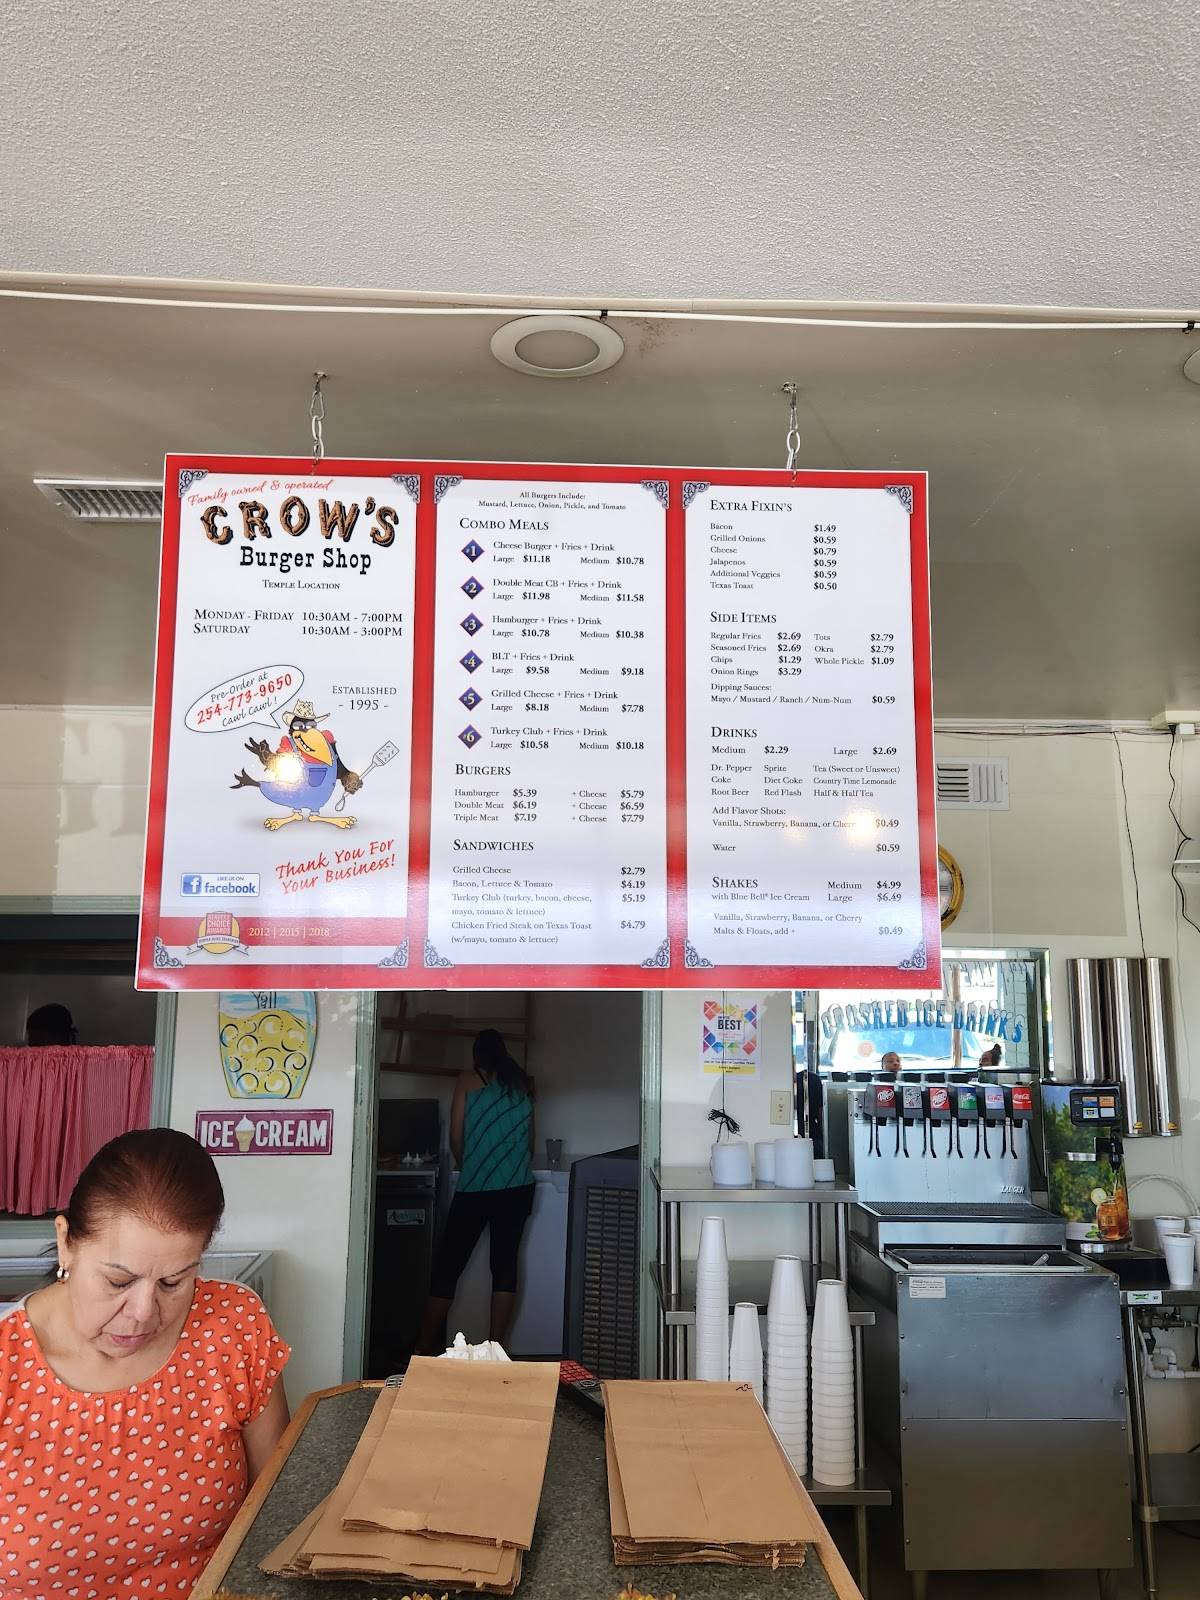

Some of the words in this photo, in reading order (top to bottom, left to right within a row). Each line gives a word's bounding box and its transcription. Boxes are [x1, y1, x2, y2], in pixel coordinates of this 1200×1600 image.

[187, 490, 228, 507] Family
[230, 484, 266, 499] owned
[270, 479, 280, 492] &
[284, 479, 334, 492] operated
[532, 492, 556, 500] Burgers
[711, 500, 747, 510] EXTRA
[200, 495, 400, 548] CROW'S
[814, 524, 836, 532] $1.49
[813, 536, 836, 544] $0.59
[525, 542, 552, 551] Burger
[240, 546, 314, 573] Burger
[323, 548, 371, 575] Shop
[494, 555, 514, 563] Large
[710, 558, 745, 566] Jalapenos
[814, 559, 836, 567] $0.59
[752, 571, 780, 579] Veggies
[814, 582, 837, 590] $0.50
[522, 592, 550, 600] $11.98
[617, 594, 644, 602] $11.58
[304, 612, 349, 621] 10:30AM
[362, 613, 402, 622] 7:00PM
[493, 616, 538, 625] Hamburger
[194, 623, 249, 633] SATURDAY
[303, 626, 349, 635] 10:30AM
[362, 627, 401, 636] 3:00PM
[493, 629, 513, 637] Large
[522, 629, 549, 637] $10.78
[616, 631, 644, 639] $10.38
[711, 632, 740, 640] Regular
[778, 632, 801, 640] $2.69
[778, 644, 801, 652] $2.69
[871, 645, 894, 653] $2.79
[711, 656, 732, 664] Chips
[210, 677, 255, 703] Pre-Order
[259, 671, 269, 682] at
[333, 686, 396, 694] ESTABLISHED
[197, 673, 292, 725] 254-773-9650
[351, 700, 378, 710] 1995
[764, 745, 788, 754] $2.29
[834, 748, 857, 756] Large
[873, 747, 896, 755] $2.69
[727, 764, 752, 773] Pepper
[764, 765, 786, 773] Sprite
[455, 789, 499, 798] Hamburger
[513, 789, 537, 797] $5.39
[621, 790, 644, 798] $5.79
[513, 801, 536, 809] $6.19
[620, 802, 644, 810] $6.59
[454, 814, 477, 823] Triple
[514, 813, 536, 822] $7.19
[622, 814, 644, 822] $7.79
[877, 844, 899, 852] $0.59
[275, 851, 330, 880] Thank
[335, 848, 366, 865] You
[369, 838, 395, 855] For
[281, 875, 319, 895] Your
[325, 853, 396, 884] Business!
[621, 867, 645, 875] $2.79
[205, 882, 256, 894] facebook
[877, 881, 901, 889] $4.99
[829, 894, 852, 903] Large
[877, 893, 901, 902] $6.49
[249, 927, 270, 936] 2012
[280, 928, 300, 937] 2015
[915, 999, 947, 1029] ICE
[718, 1019, 742, 1030] BEST
[200, 1120, 235, 1148] ICE
[255, 1120, 327, 1147] CREAM
